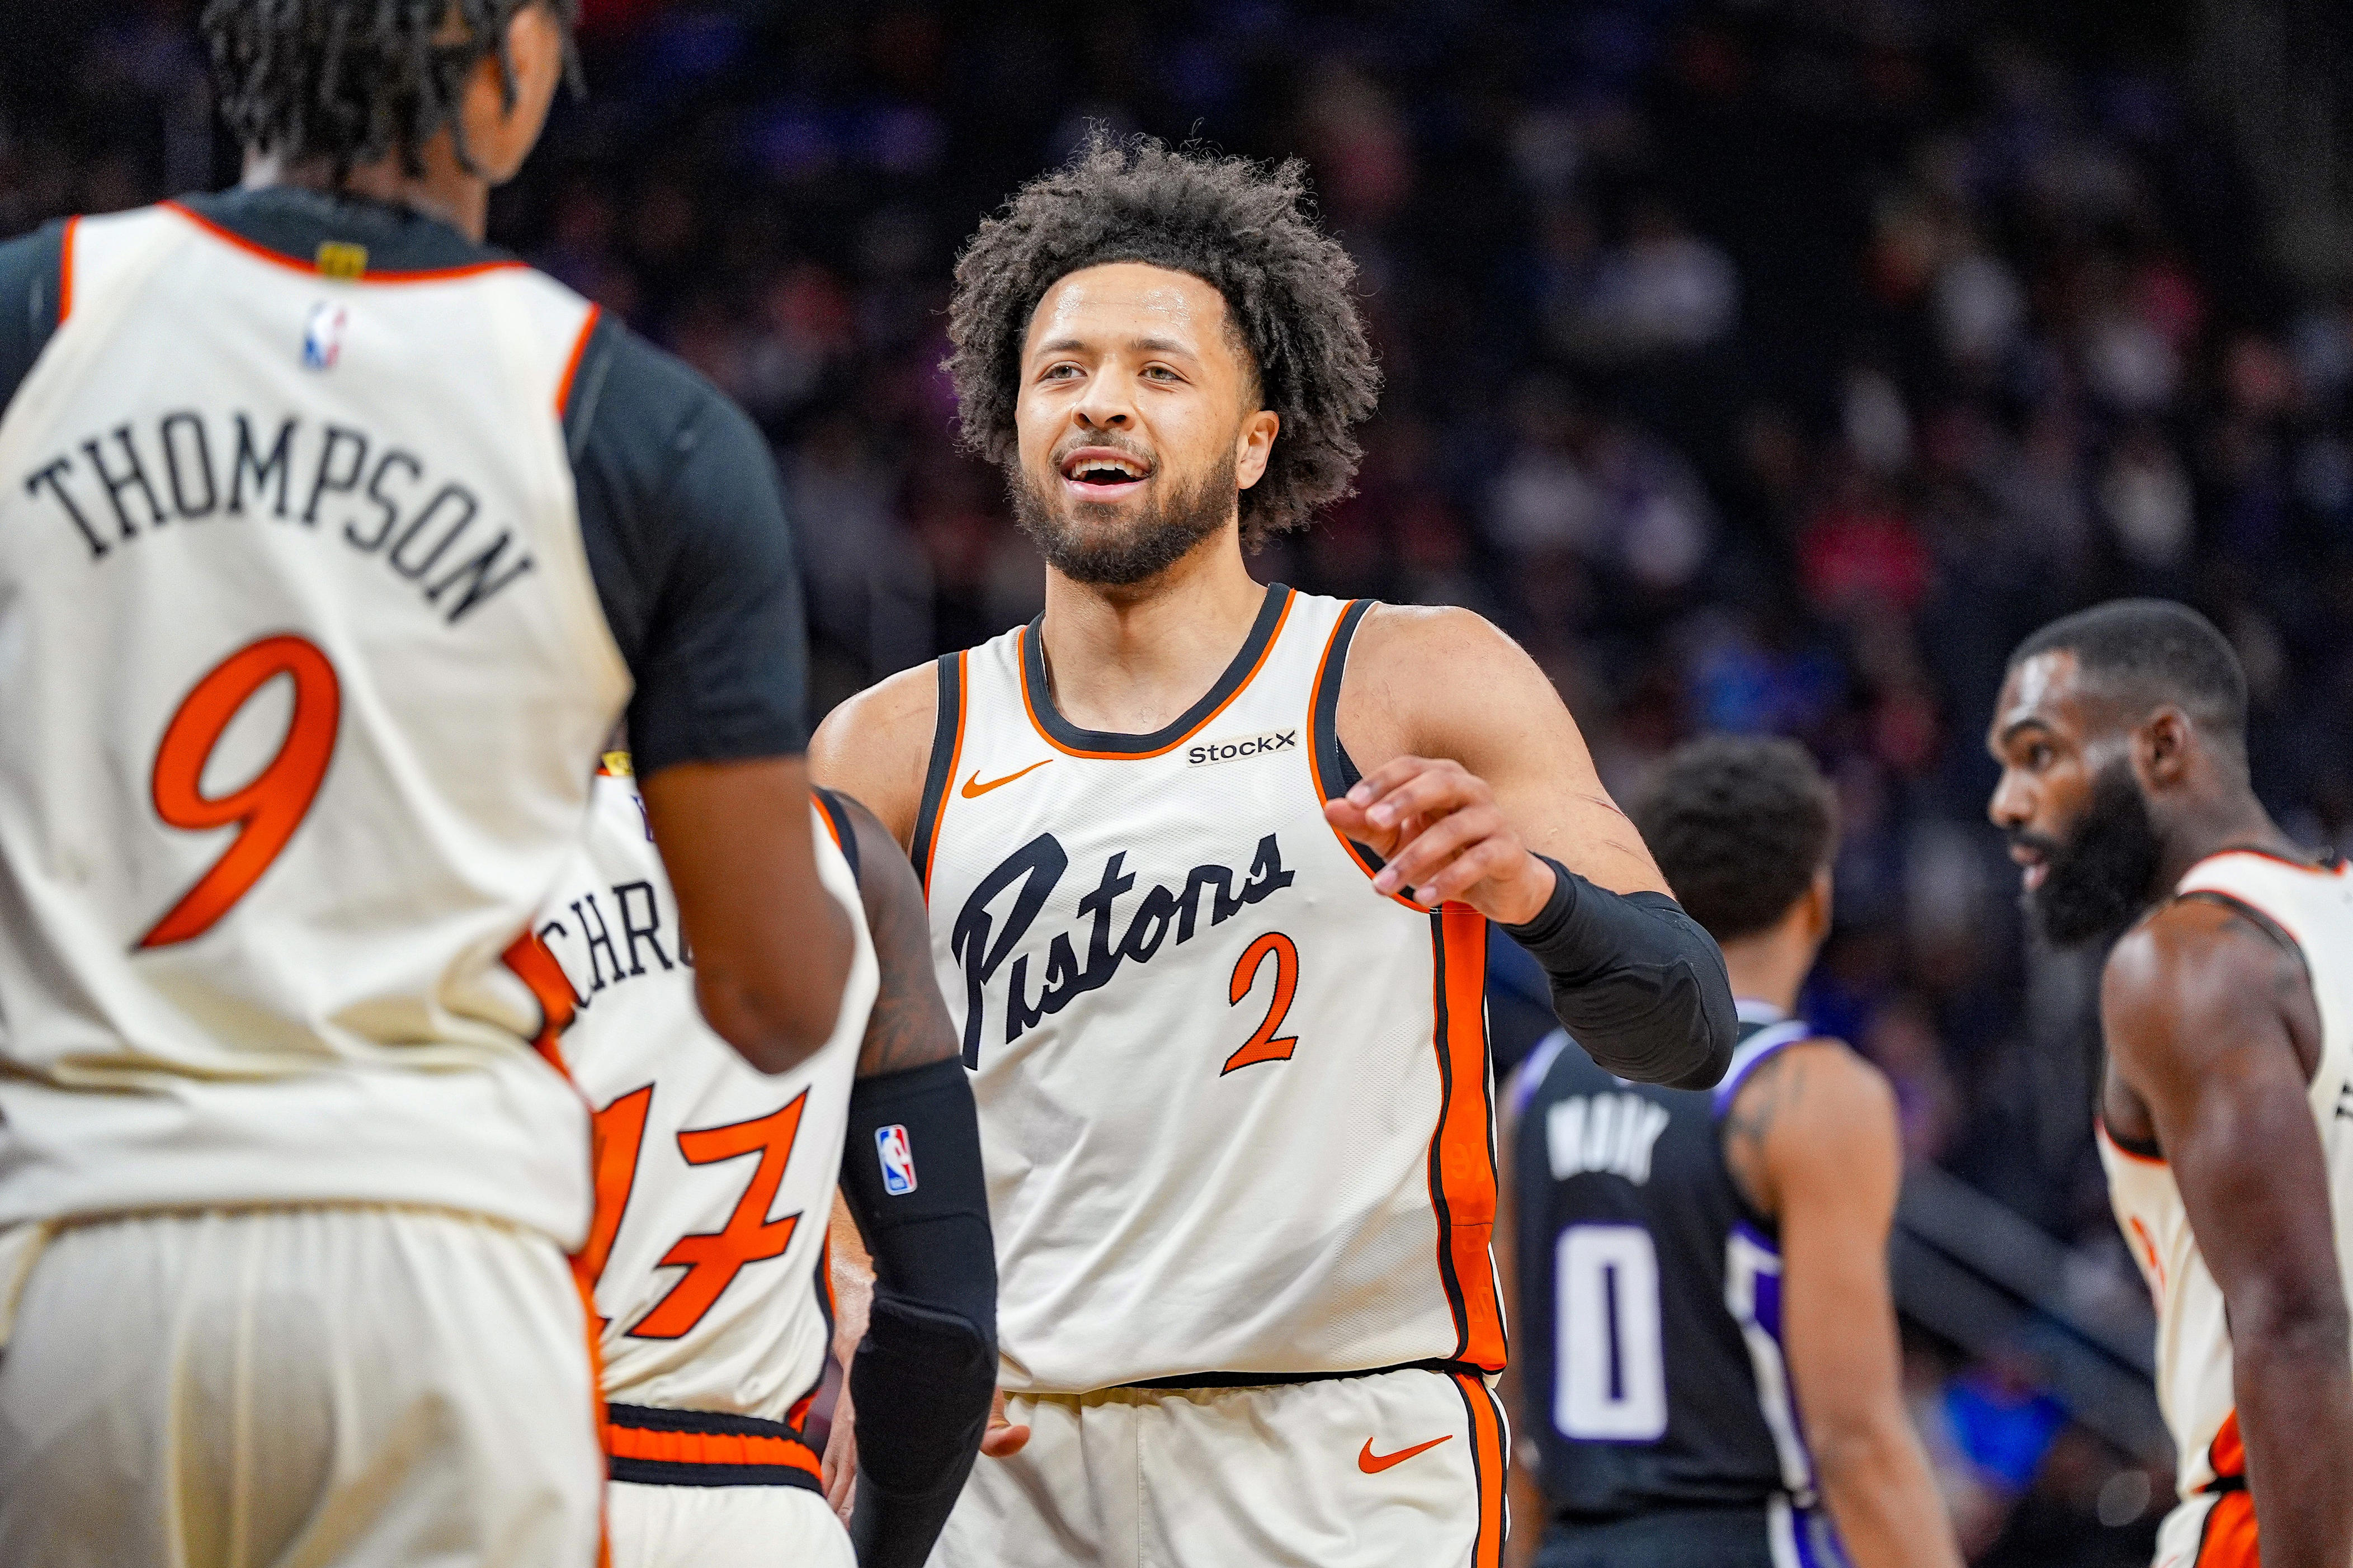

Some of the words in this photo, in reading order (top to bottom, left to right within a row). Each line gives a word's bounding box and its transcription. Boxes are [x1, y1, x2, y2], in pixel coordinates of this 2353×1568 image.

[26, 410, 535, 624] THOMPSON
[131, 633, 342, 953] 9
[1189, 730, 1295, 764] StockX
[951, 832, 1295, 1071] Pistons
[1219, 931, 1299, 1077] 2
[1555, 1222, 1669, 1443] 0
